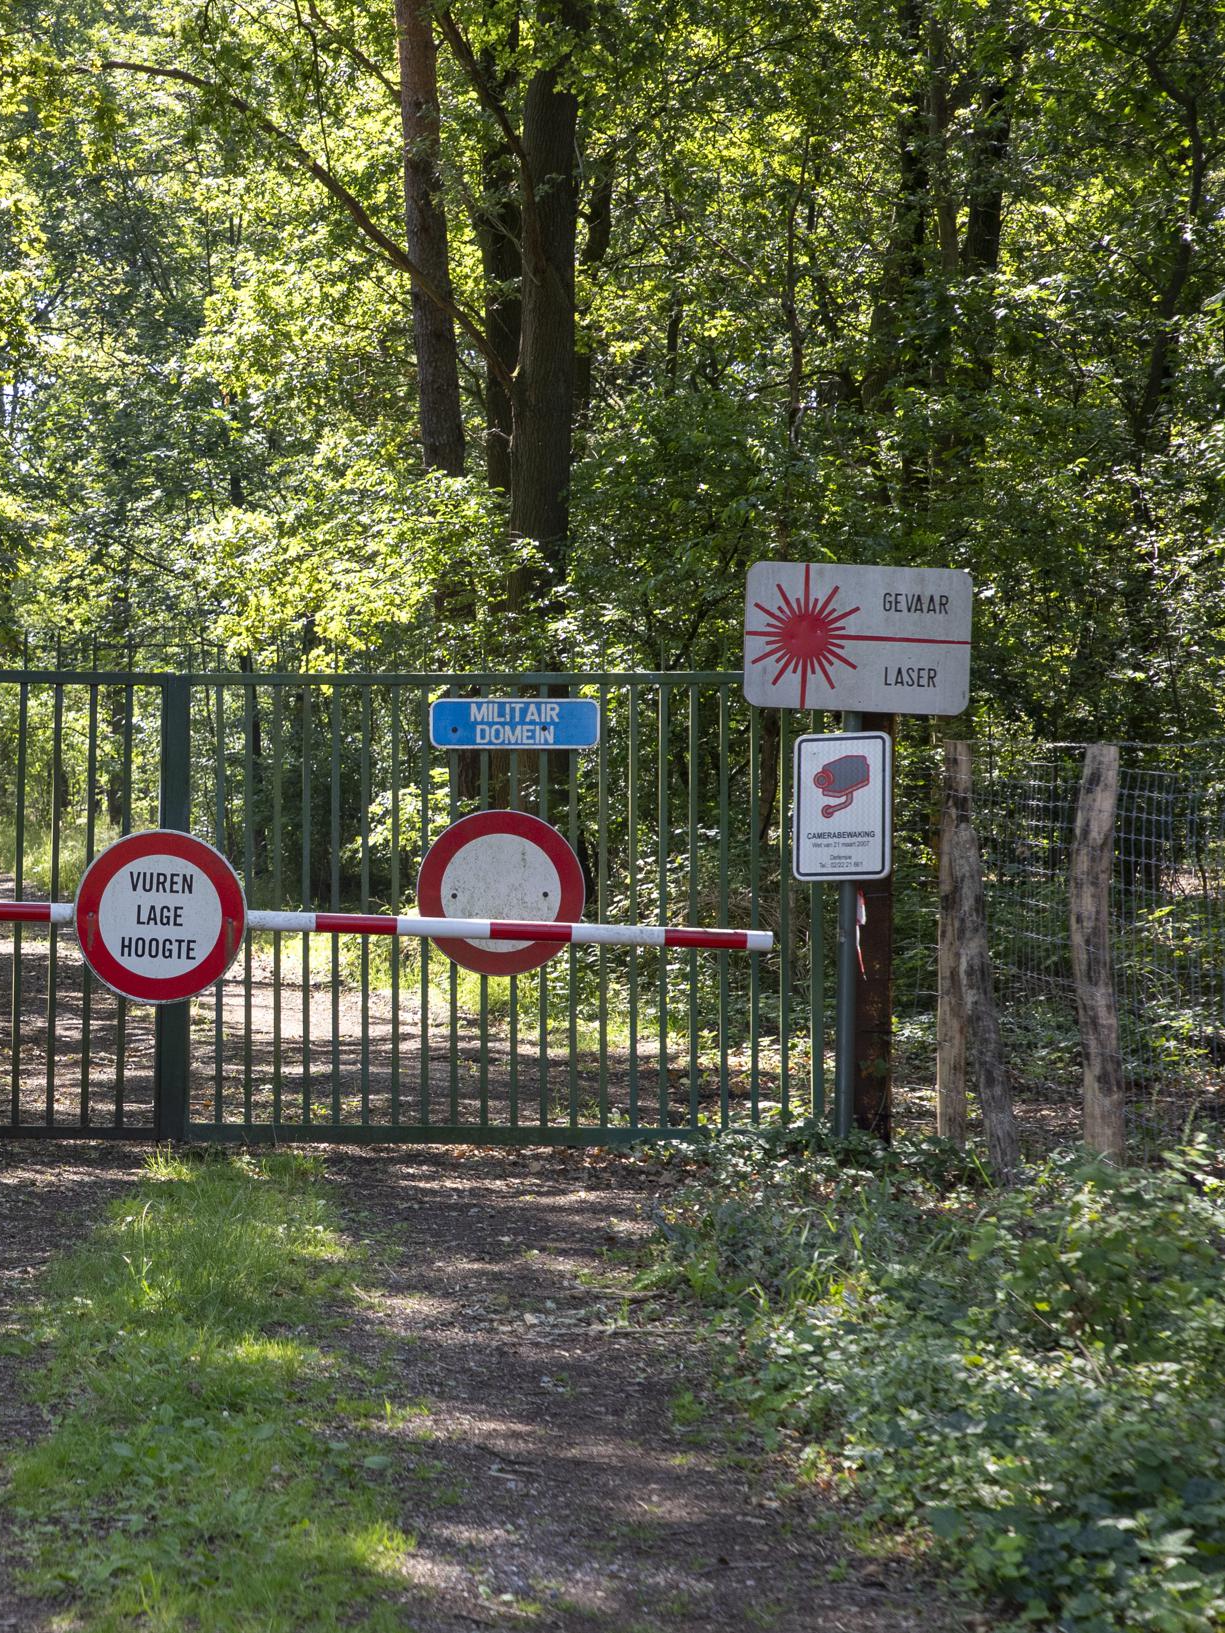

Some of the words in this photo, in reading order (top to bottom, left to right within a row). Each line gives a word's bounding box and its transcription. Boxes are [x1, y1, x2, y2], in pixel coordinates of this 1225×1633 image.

[883, 592, 949, 614] GEVAAR
[884, 666, 937, 688] LASER
[470, 703, 559, 722] MILITAIR
[476, 725, 554, 744] DOMEIN
[807, 830, 876, 840] CAMERABEWAKING
[129, 871, 194, 894] VUREN
[136, 904, 183, 927] LAGE
[120, 936, 197, 960] HOOGTE
